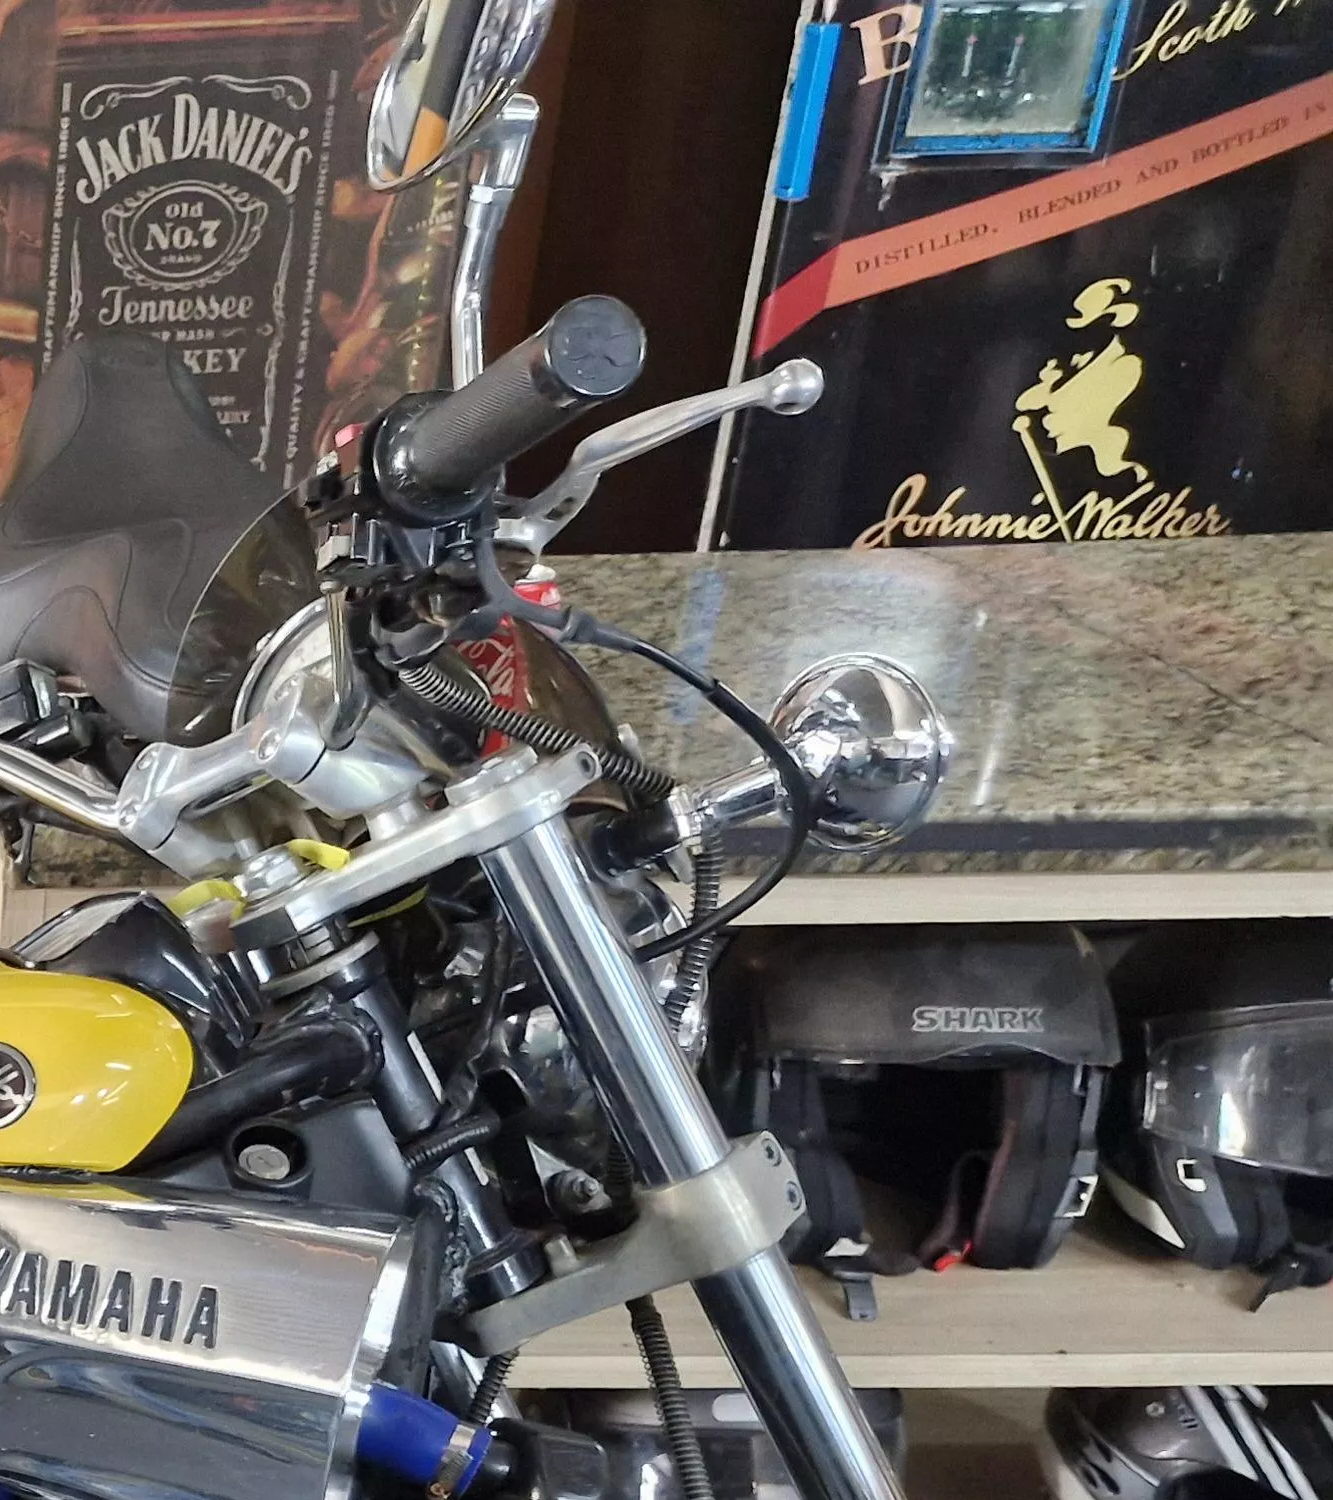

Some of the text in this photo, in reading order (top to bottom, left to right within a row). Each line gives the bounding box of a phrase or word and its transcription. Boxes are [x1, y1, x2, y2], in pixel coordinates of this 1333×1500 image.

[75, 92, 314, 204] JACK DANIEL'S
[1016, 178, 1123, 225] BLENDED
[1136, 158, 1180, 184] AND
[1190, 115, 1290, 165] BOTTLED
[53, 163, 67, 218] SINCE
[164, 201, 205, 219] Old
[98, 285, 254, 326] Tennessee
[183, 347, 247, 375] KEY
[851, 473, 1233, 550] Johnnie Walker
[911, 1006, 1045, 1034] SHARK
